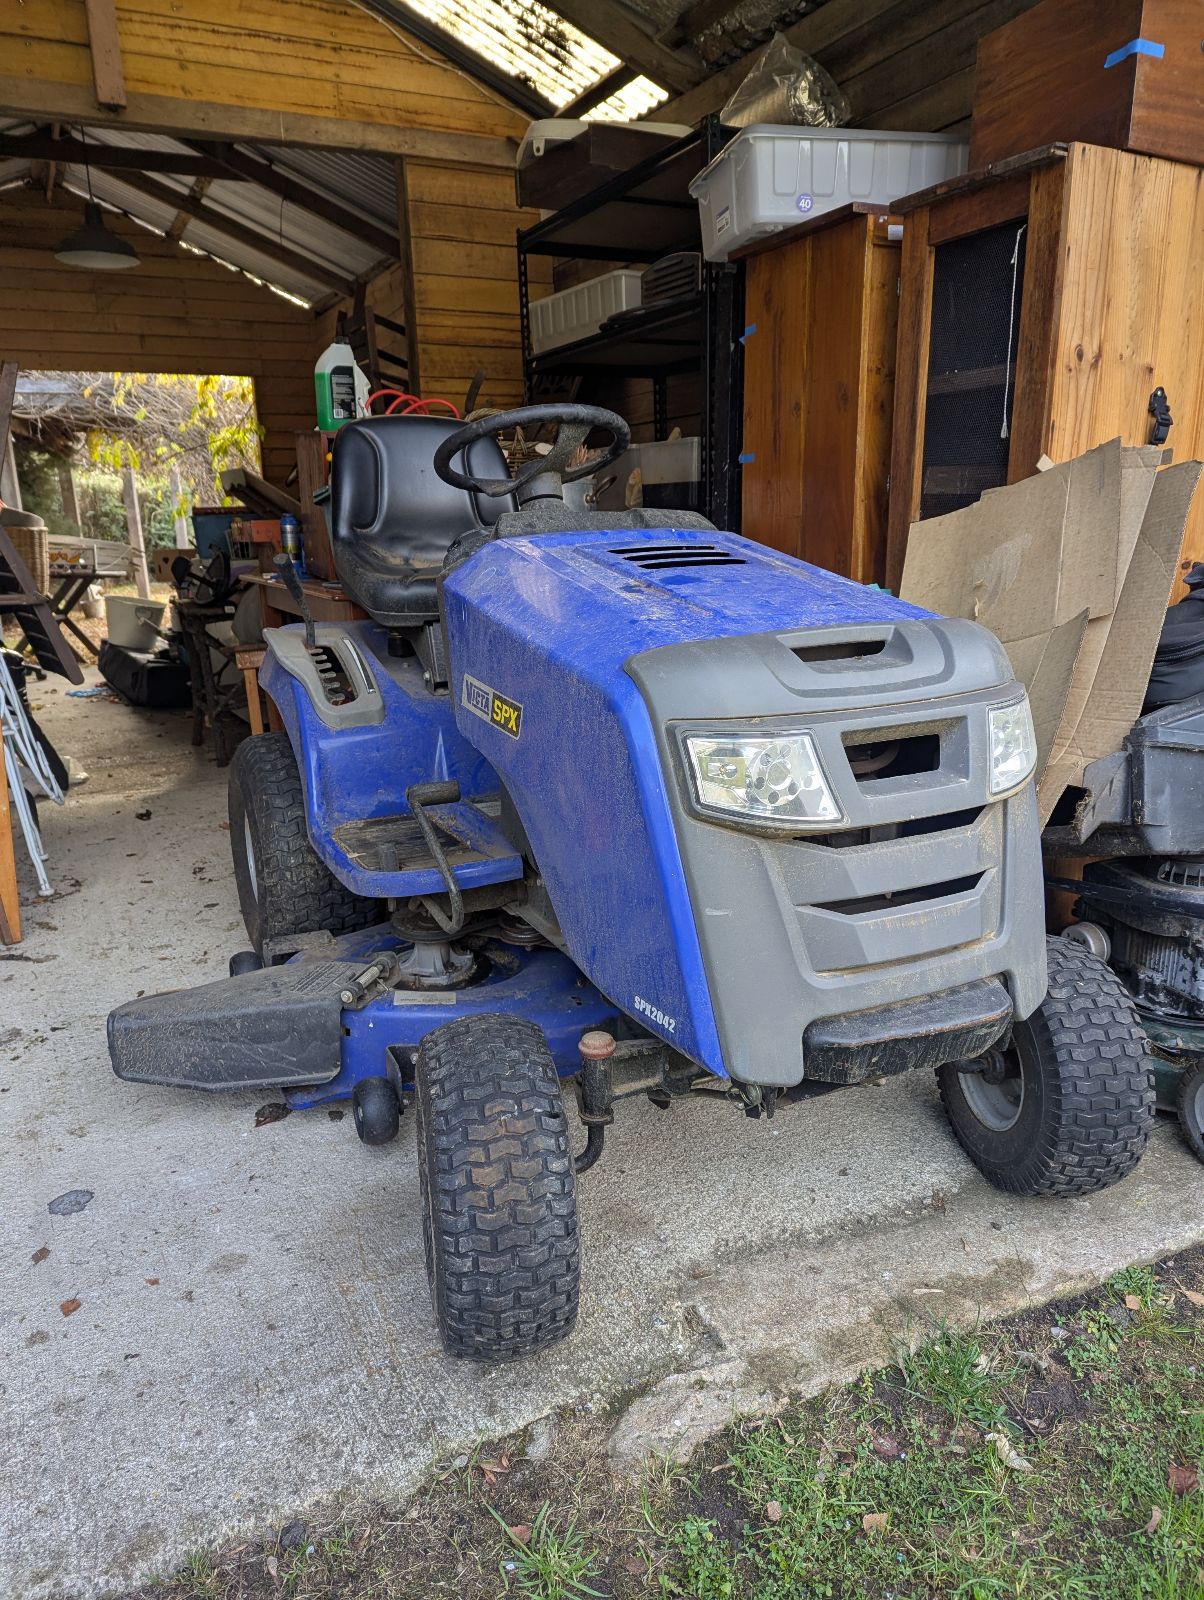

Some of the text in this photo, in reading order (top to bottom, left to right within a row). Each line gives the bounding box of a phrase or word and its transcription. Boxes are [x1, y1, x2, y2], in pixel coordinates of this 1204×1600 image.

[799, 198, 811, 209] 40
[493, 699, 518, 731] SPX
[634, 995, 676, 1033] SPX2042
